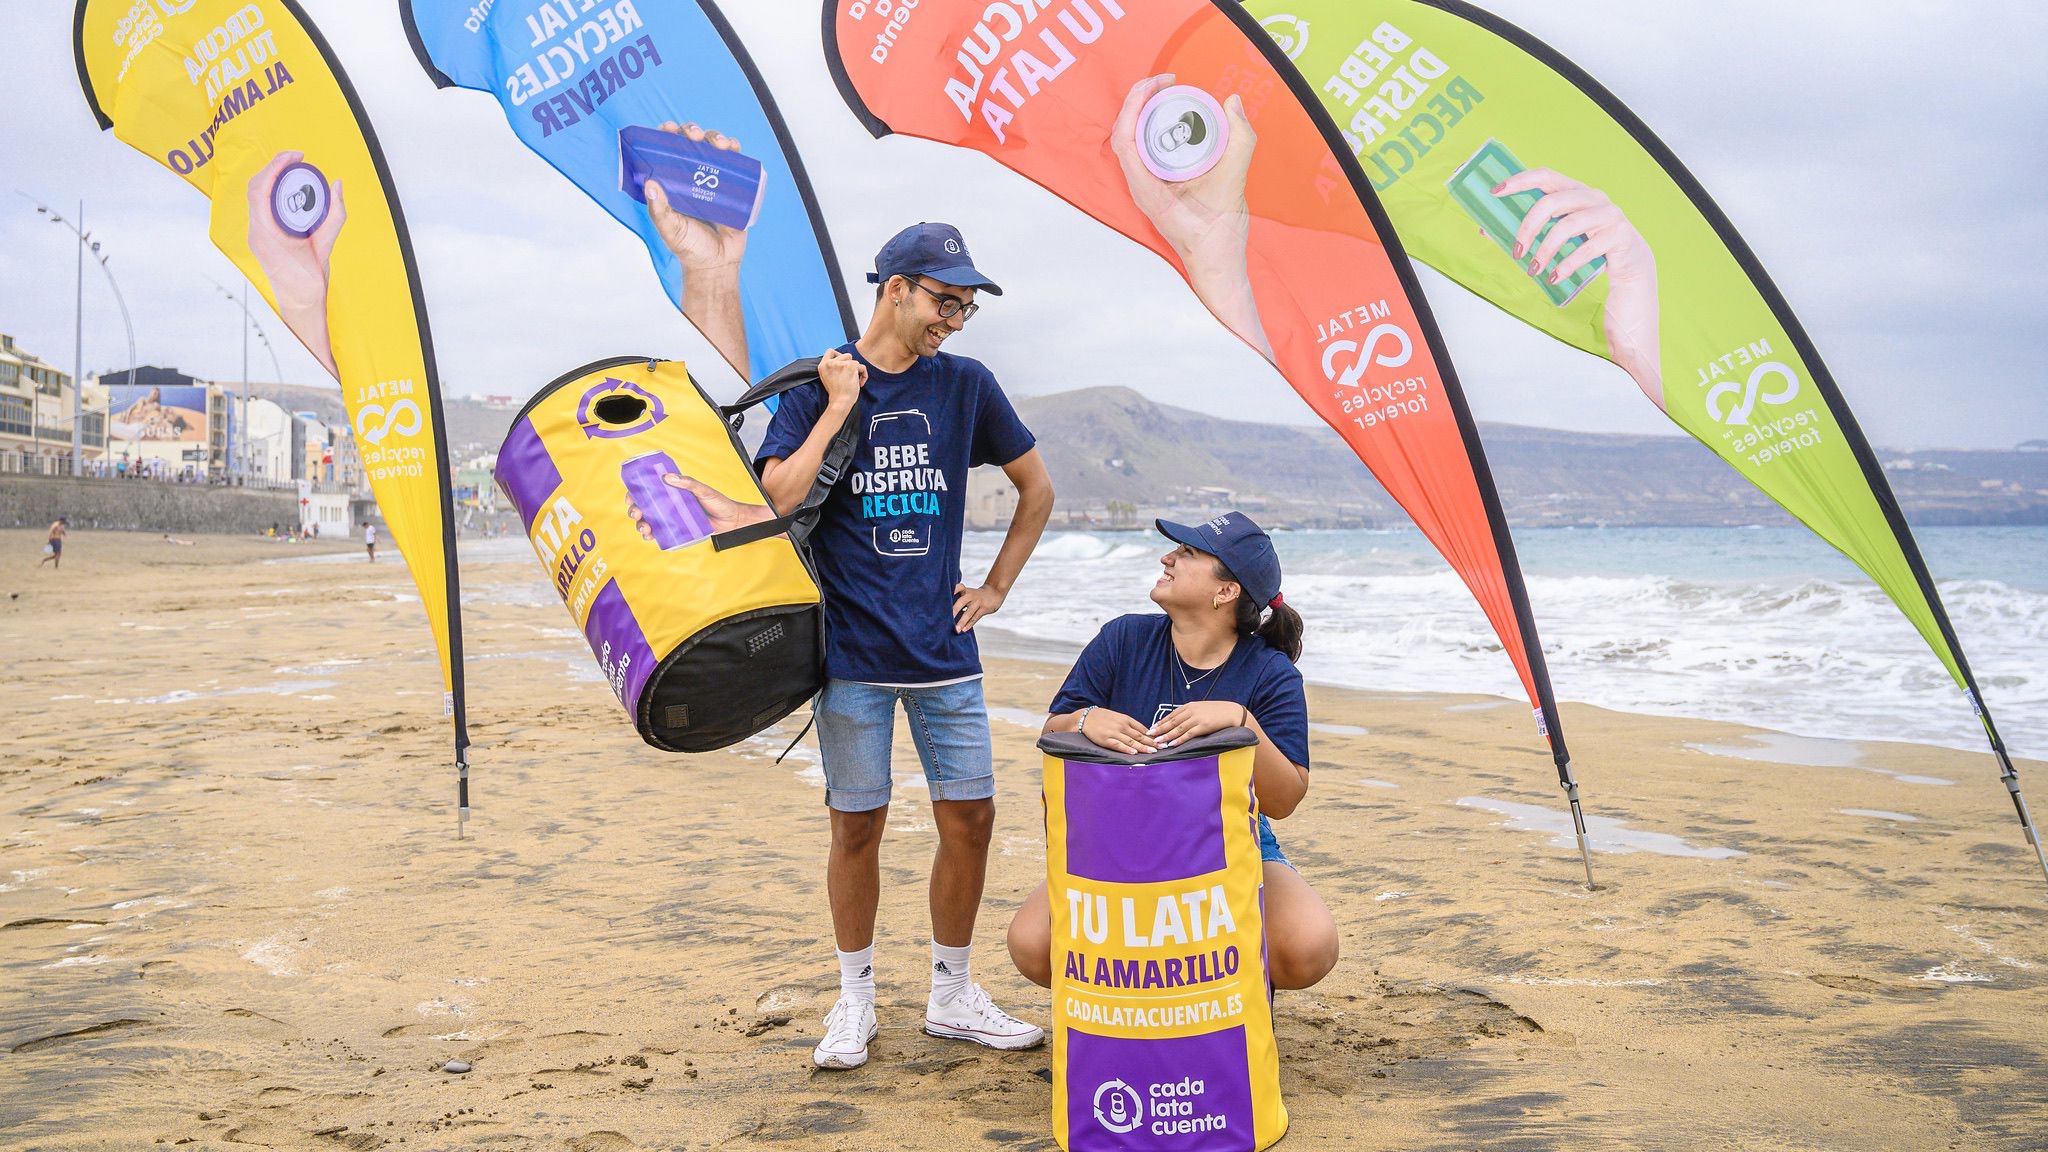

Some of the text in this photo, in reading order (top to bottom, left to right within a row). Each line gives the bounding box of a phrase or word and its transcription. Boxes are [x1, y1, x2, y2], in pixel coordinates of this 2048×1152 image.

[874, 443, 930, 469] BEBE
[851, 468, 948, 495] DISFRUTA
[862, 491, 940, 519] RECICLA
[535, 496, 583, 575] ATA
[1066, 884, 1237, 948] TU LATA
[1065, 945, 1240, 989] AL AMARILLO
[1066, 993, 1244, 1027] CADALATACUENTA.ES
[1149, 1076, 1205, 1098] cada
[1150, 1097, 1192, 1118] lata
[1151, 1113, 1227, 1136] cuenta
